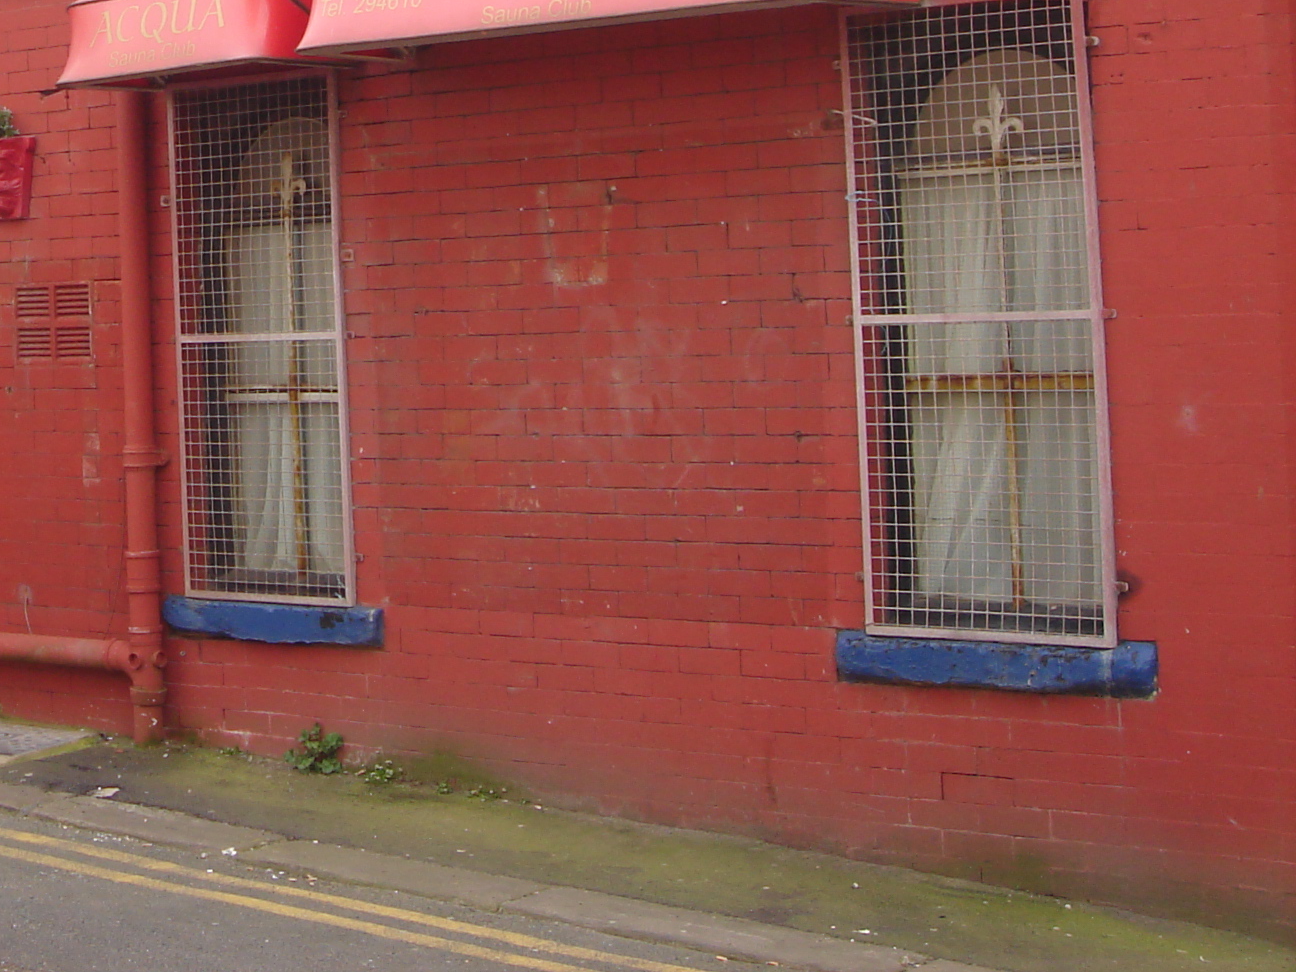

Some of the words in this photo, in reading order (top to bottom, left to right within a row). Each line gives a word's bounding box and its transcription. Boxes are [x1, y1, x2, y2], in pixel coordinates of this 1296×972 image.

[480, 5, 540, 25] Sauna
[109, 49, 156, 67] Sauna
[160, 40, 196, 60] Club
